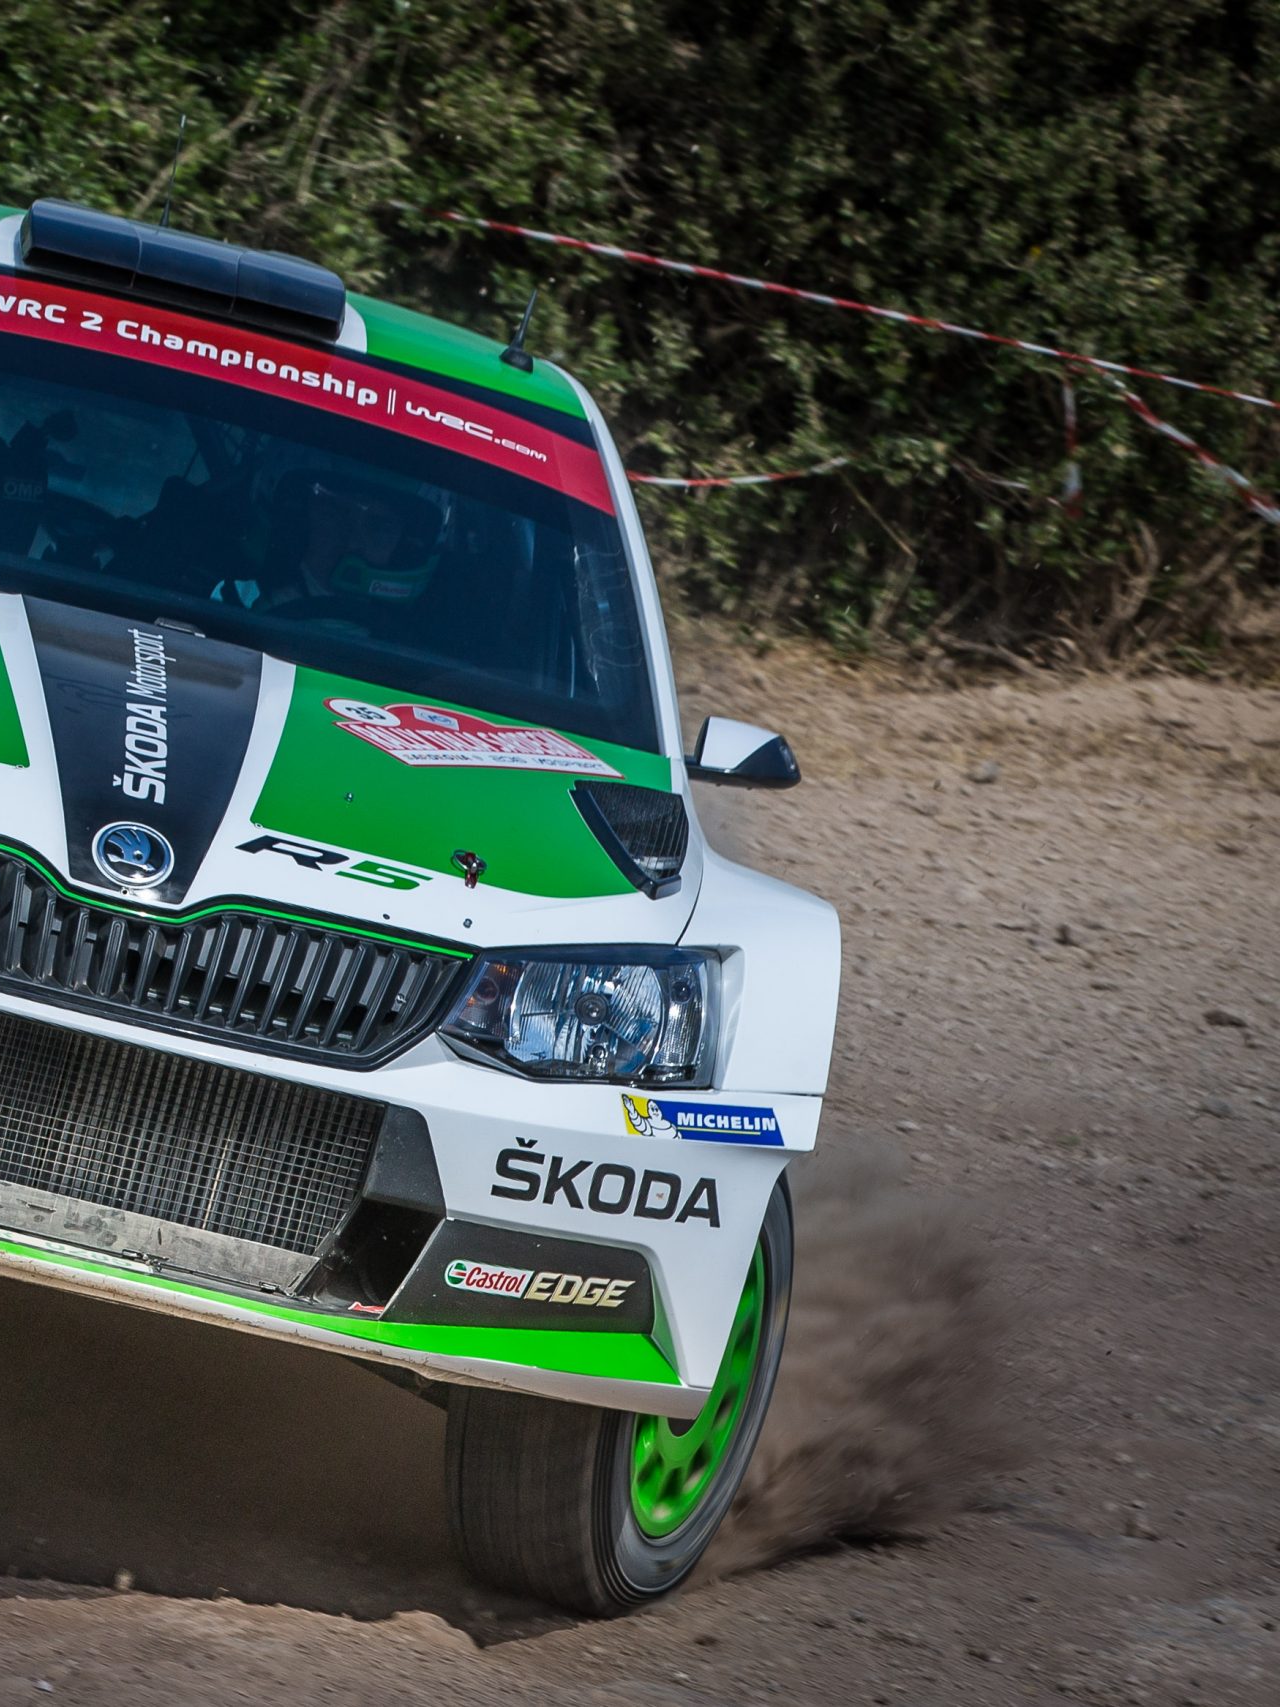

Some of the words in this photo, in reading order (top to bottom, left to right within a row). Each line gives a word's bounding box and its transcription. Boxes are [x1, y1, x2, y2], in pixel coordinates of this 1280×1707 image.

[80, 311, 102, 332] 2
[116, 319, 379, 406] Championship
[4, 480, 42, 499] OMP
[126, 628, 176, 702] Motorsport
[112, 702, 168, 805] ŠKODA
[676, 1111, 777, 1132] MICHELIN
[490, 1136, 721, 1229] ŠKODA
[464, 1266, 526, 1294] Castrol
[523, 1271, 636, 1308] EDGE
